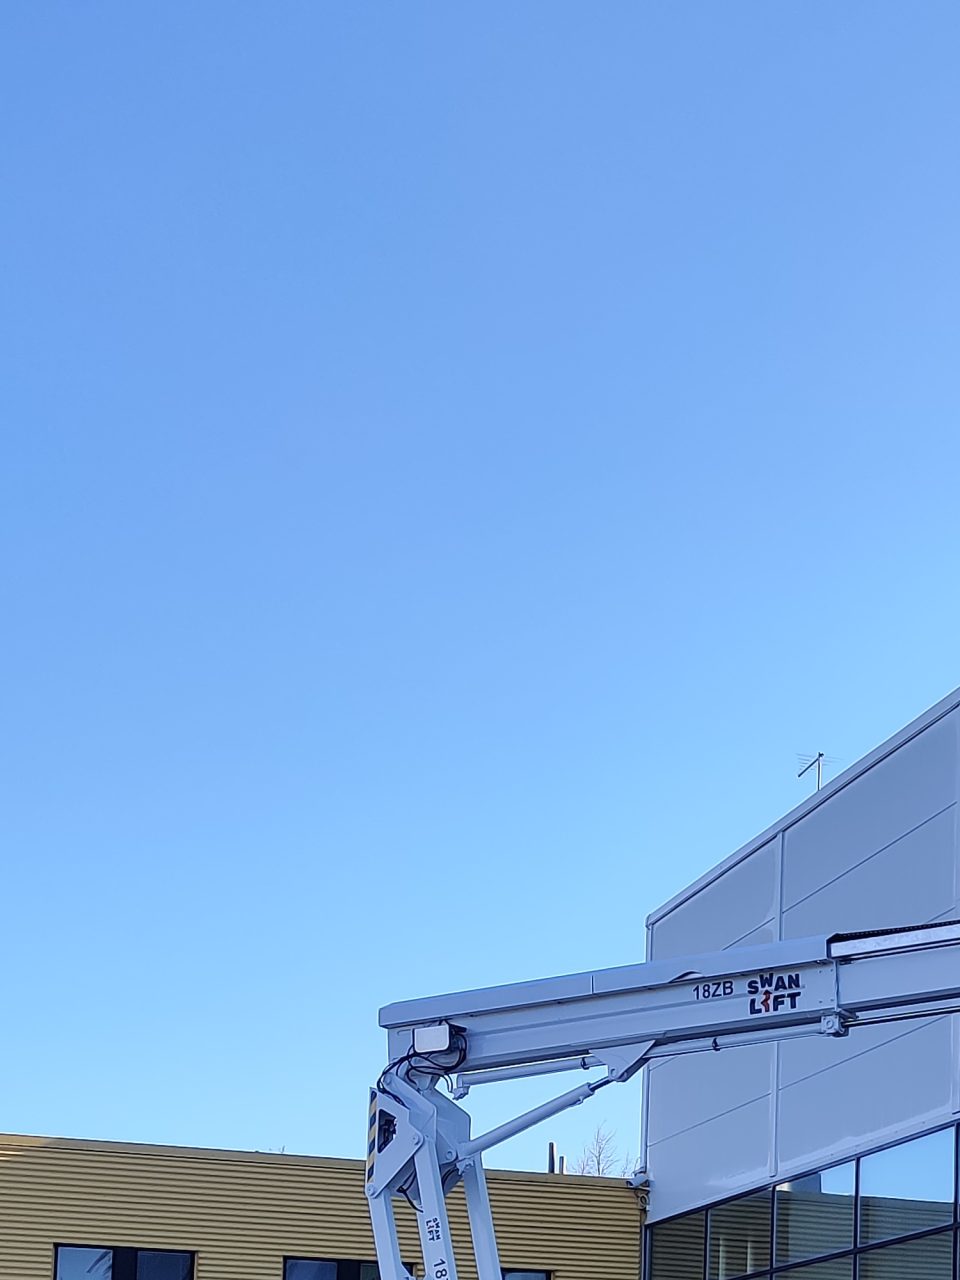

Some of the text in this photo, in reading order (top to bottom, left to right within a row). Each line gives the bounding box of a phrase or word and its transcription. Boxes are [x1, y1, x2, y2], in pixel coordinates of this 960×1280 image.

[692, 980, 734, 1000] 18ZB
[747, 972, 801, 995] SWAN
[749, 991, 802, 1015] LIFT
